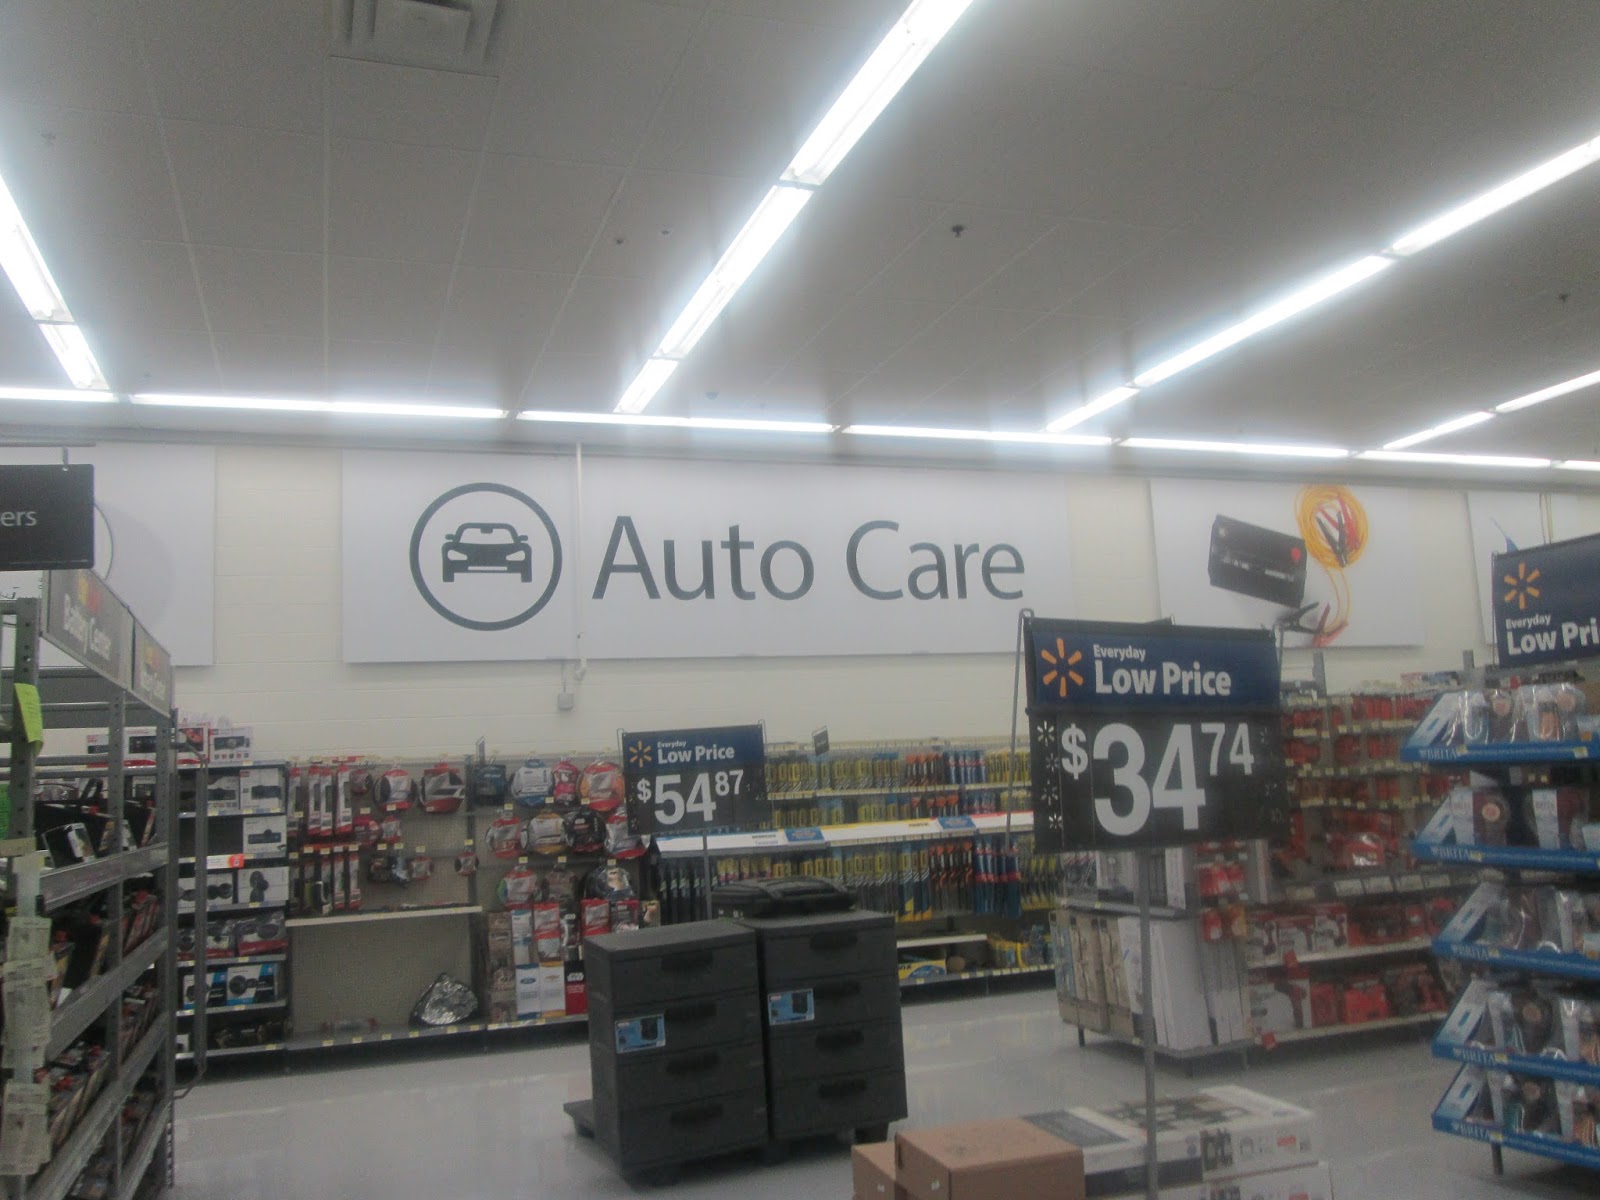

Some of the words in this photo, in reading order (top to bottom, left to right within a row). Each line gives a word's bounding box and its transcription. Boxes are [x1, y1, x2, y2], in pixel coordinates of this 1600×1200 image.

[592, 516, 814, 600] Auto
[846, 520, 1025, 600] Care
[1505, 614, 1551, 630] Everyday
[1506, 629, 1556, 656] Low
[1561, 618, 1600, 647] Pri
[1093, 644, 1146, 662] Everyday
[1094, 660, 1156, 694] Low
[1162, 661, 1232, 696] Price
[657, 741, 687, 749] Everyday
[657, 749, 692, 764] Low
[695, 744, 735, 761] Price
